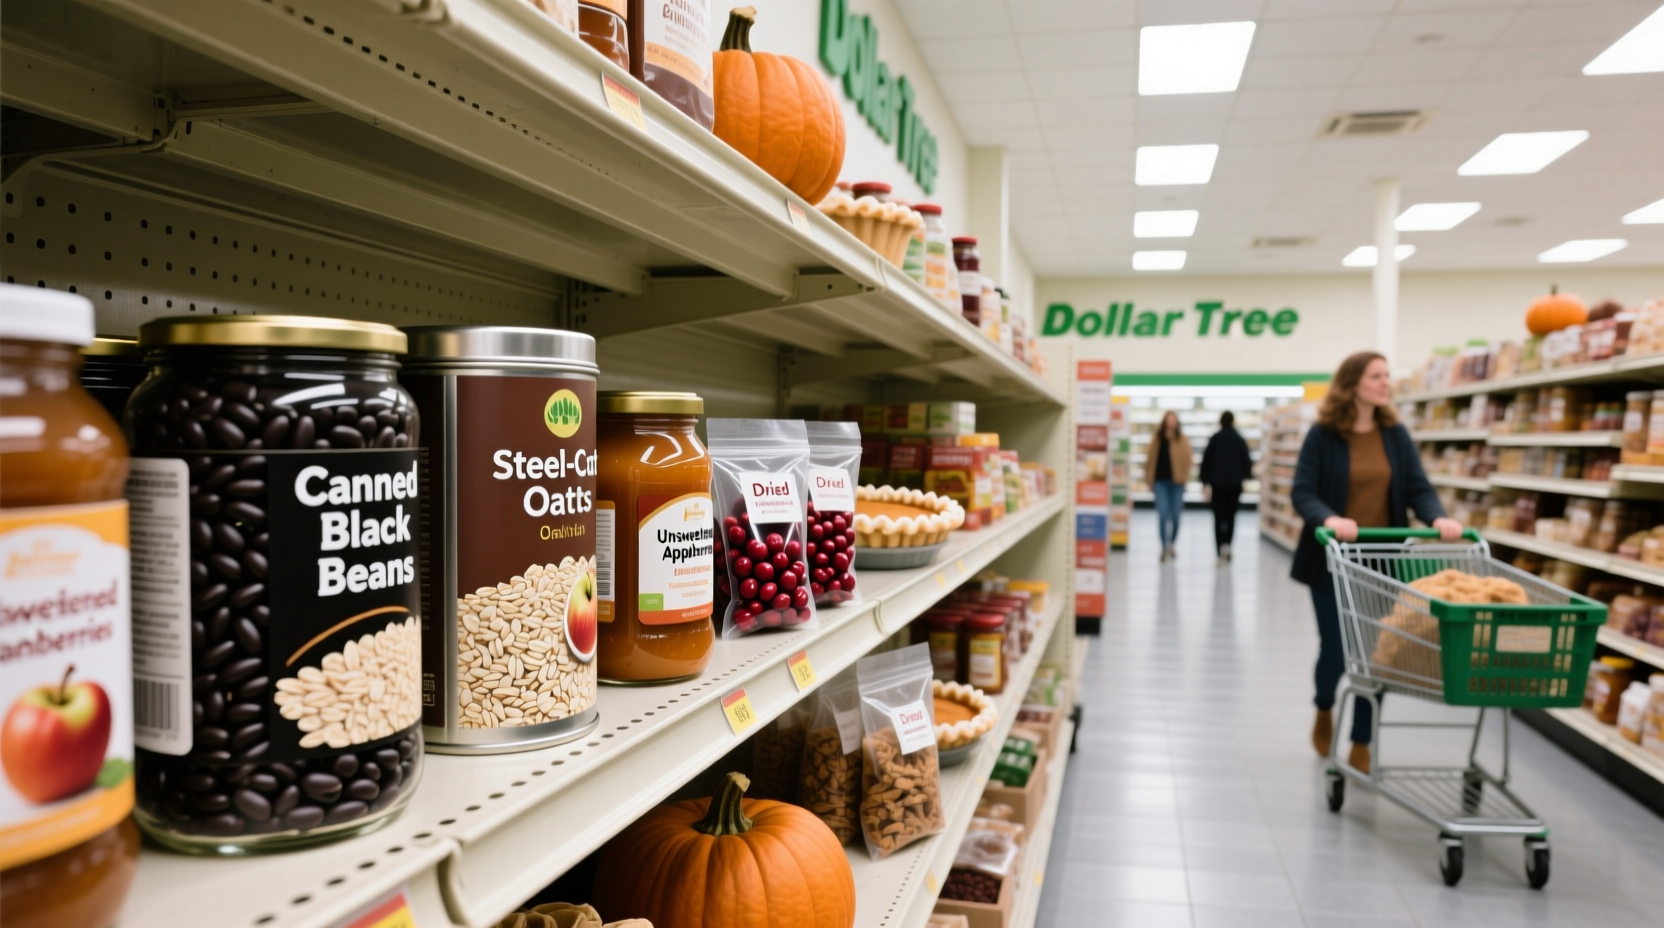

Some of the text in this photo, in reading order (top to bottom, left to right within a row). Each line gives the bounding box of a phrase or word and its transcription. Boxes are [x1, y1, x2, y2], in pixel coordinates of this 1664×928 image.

[819, 0, 939, 196] Dollar Tree
[1041, 301, 1299, 337] Dollar Tree
[294, 460, 418, 507] Canned
[523, 485, 592, 517] Oatts
[752, 481, 790, 497] Dried
[320, 504, 411, 551] Black
[317, 556, 415, 597] Beans
